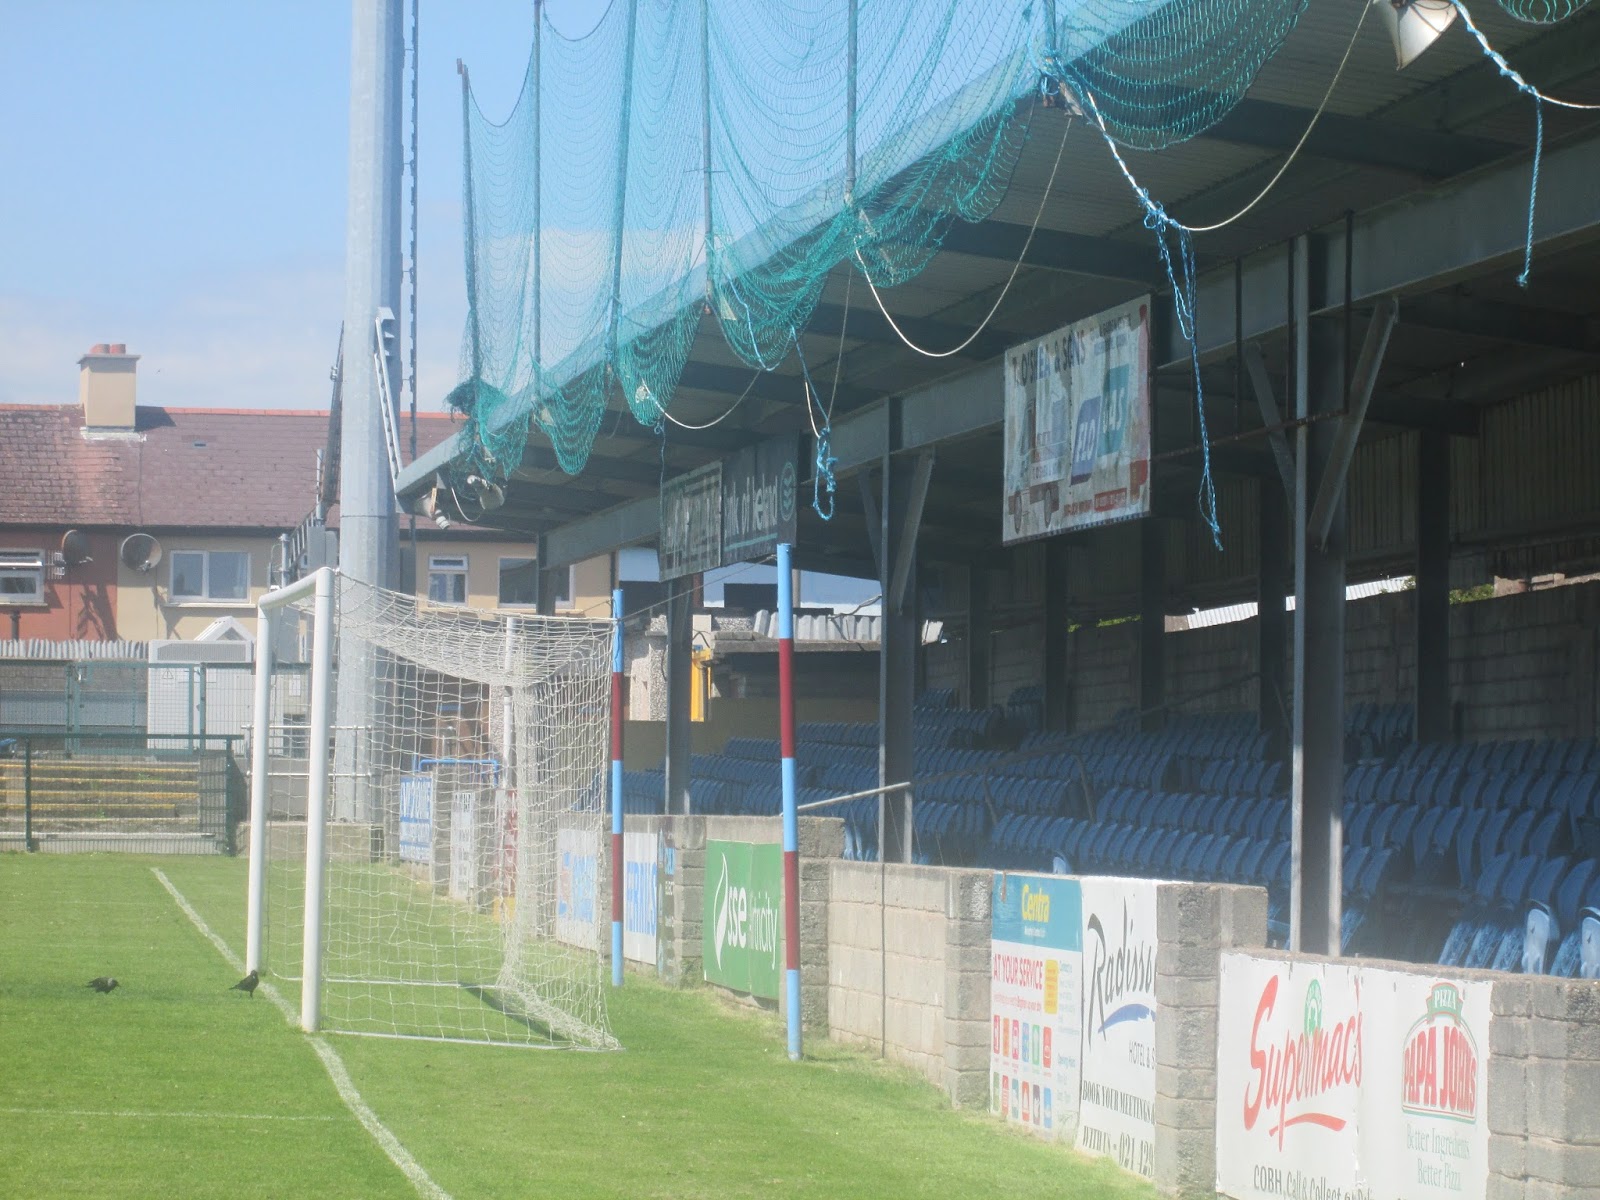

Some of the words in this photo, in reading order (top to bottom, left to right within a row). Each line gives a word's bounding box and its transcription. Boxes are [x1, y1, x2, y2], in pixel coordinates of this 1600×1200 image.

[1062, 329, 1086, 371] SONS
[727, 886, 747, 949] sse
[1022, 884, 1050, 923] Centra
[1001, 956, 1018, 986] YOUR
[1019, 959, 1043, 990] SERVICE
[1087, 896, 1156, 1052] Radisso
[1434, 989, 1456, 1010] PIZZA
[1129, 1039, 1145, 1067] HOTEL
[1244, 975, 1363, 1152] Supermac's
[1403, 1026, 1437, 1107] PAPA
[1082, 1080, 1100, 1106] BOOK
[1101, 1085, 1119, 1112] YOUR
[1120, 1091, 1150, 1124] MEETINGS
[1082, 1125, 1101, 1151] WITH
[1119, 1131, 1135, 1171] 021
[1406, 1123, 1430, 1153] Better
[1431, 1127, 1470, 1161] Ingredients
[1417, 1157, 1442, 1187] Better
